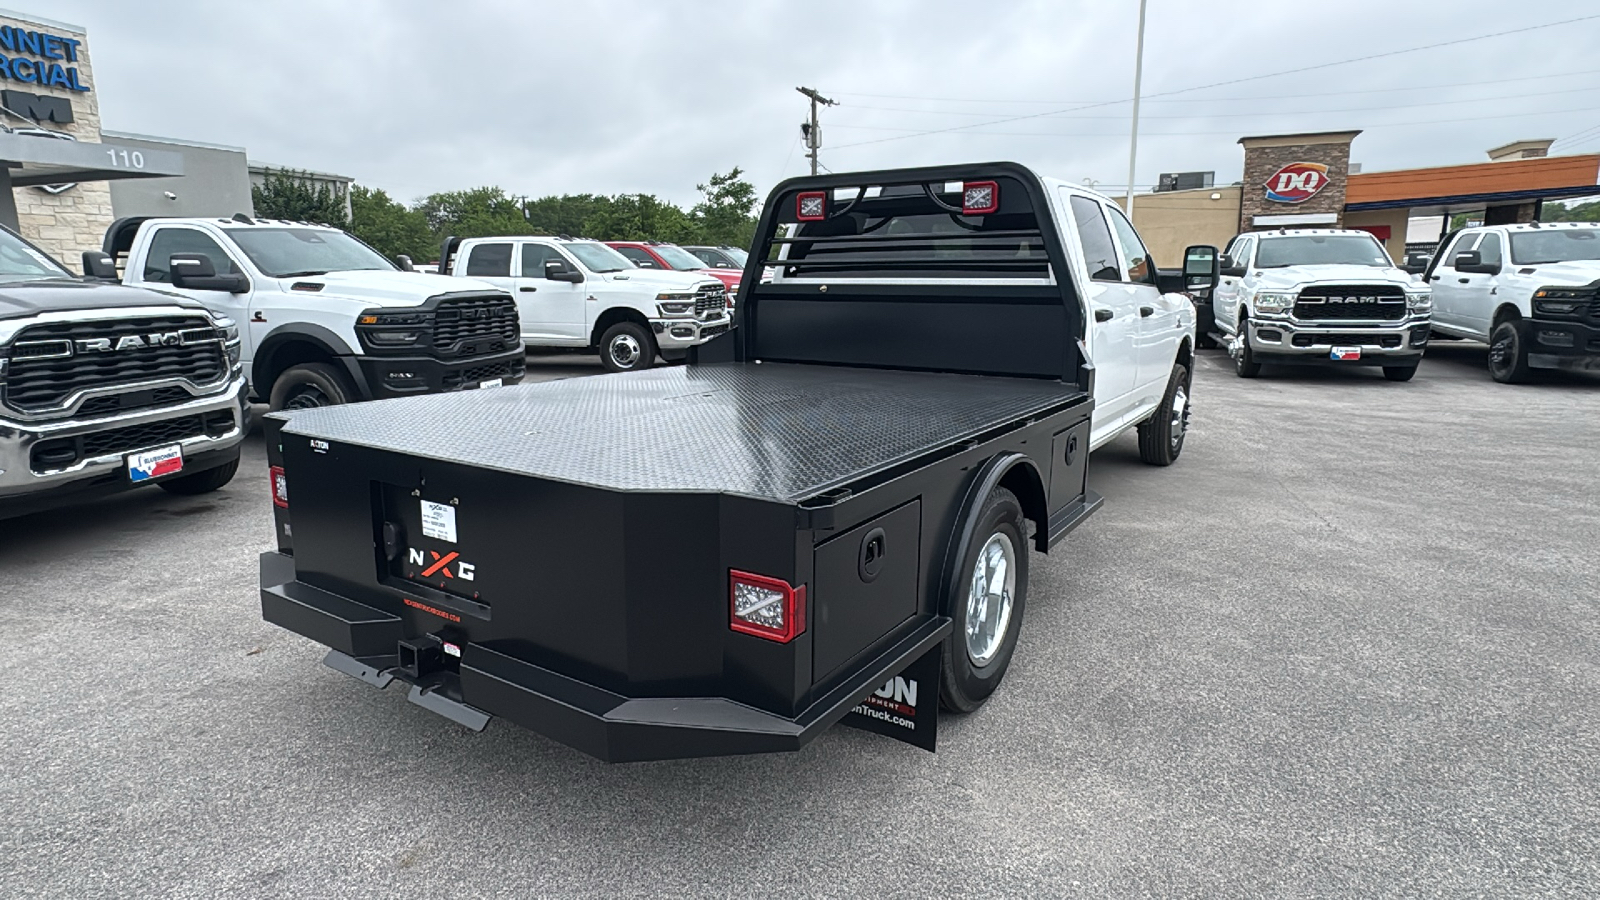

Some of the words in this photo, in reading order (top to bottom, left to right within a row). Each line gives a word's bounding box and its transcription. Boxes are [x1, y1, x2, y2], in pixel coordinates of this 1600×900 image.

[106, 149, 144, 169] 110
[1275, 171, 1319, 193] DQ
[1328, 296, 1376, 304] RAM
[75, 332, 179, 354] RAM
[409, 547, 476, 581] NXG
